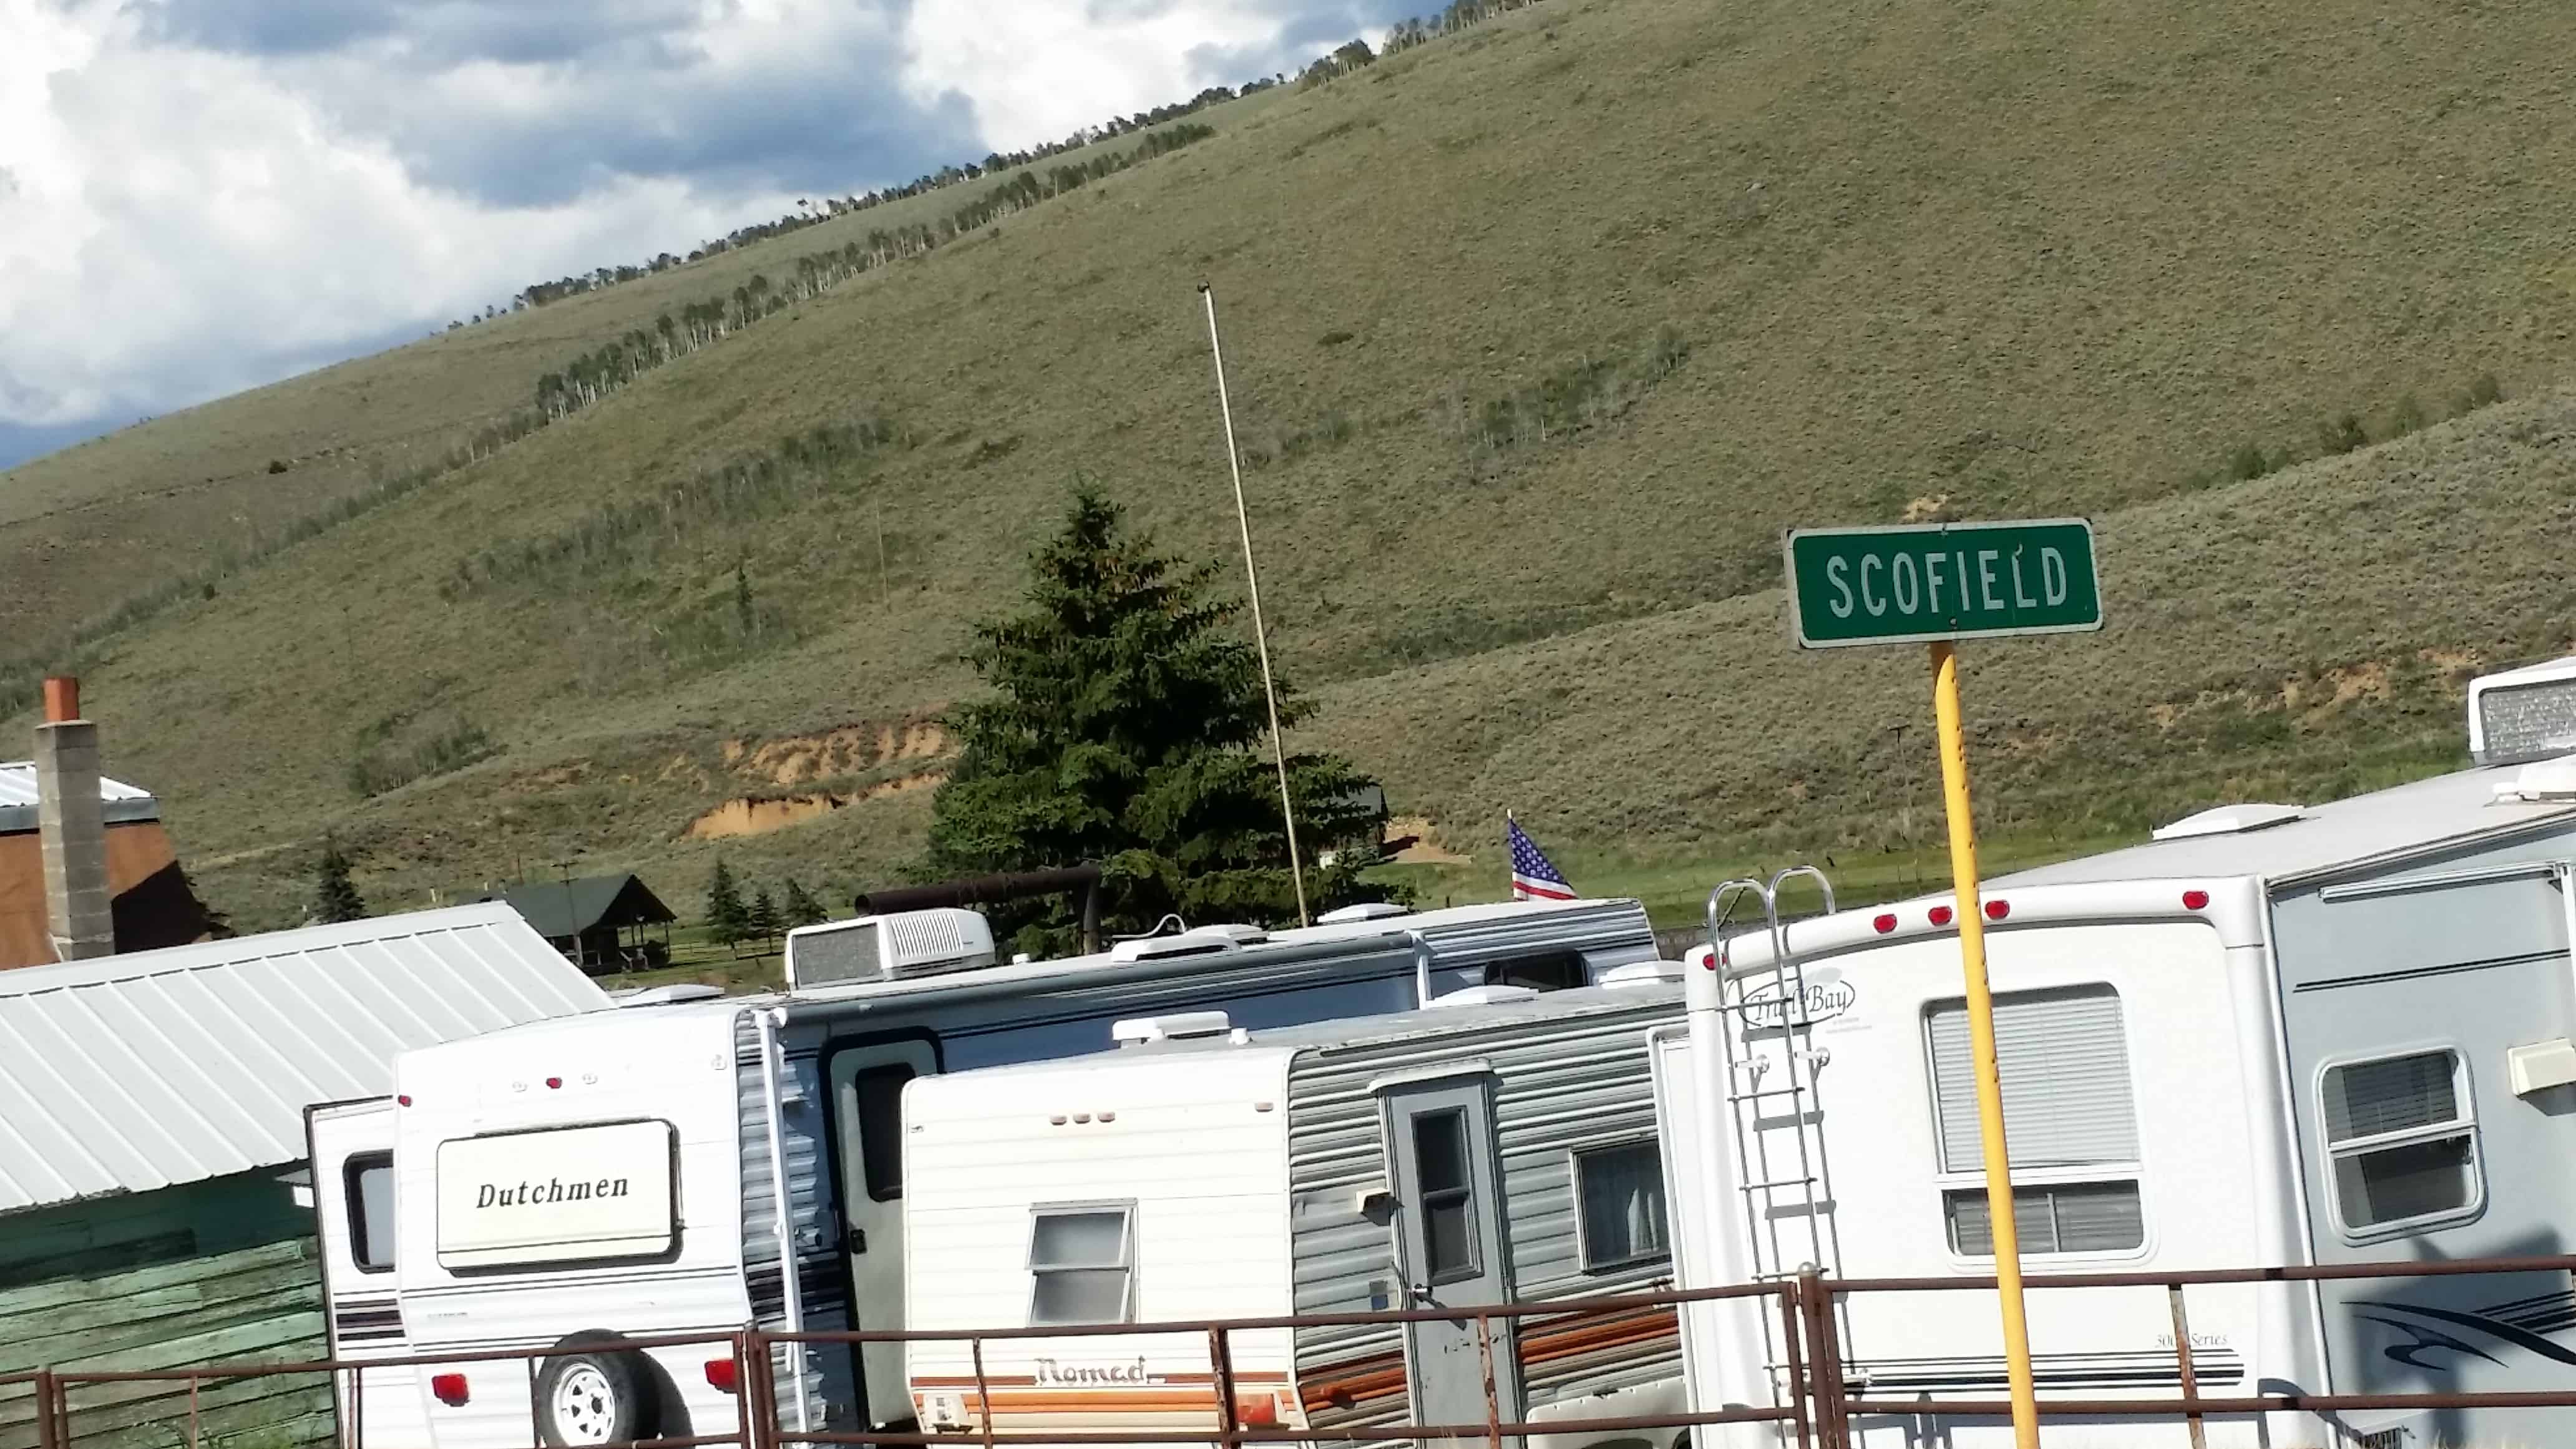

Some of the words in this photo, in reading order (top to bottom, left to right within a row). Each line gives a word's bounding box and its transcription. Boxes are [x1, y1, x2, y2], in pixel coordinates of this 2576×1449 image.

[1827, 547, 2067, 618] SCOFIELD
[1806, 985, 1846, 1014] Bay
[477, 1177, 628, 1208] Dutchmen
[2191, 1333, 2227, 1347] Series
[1033, 1355, 1146, 1383] Nomad
